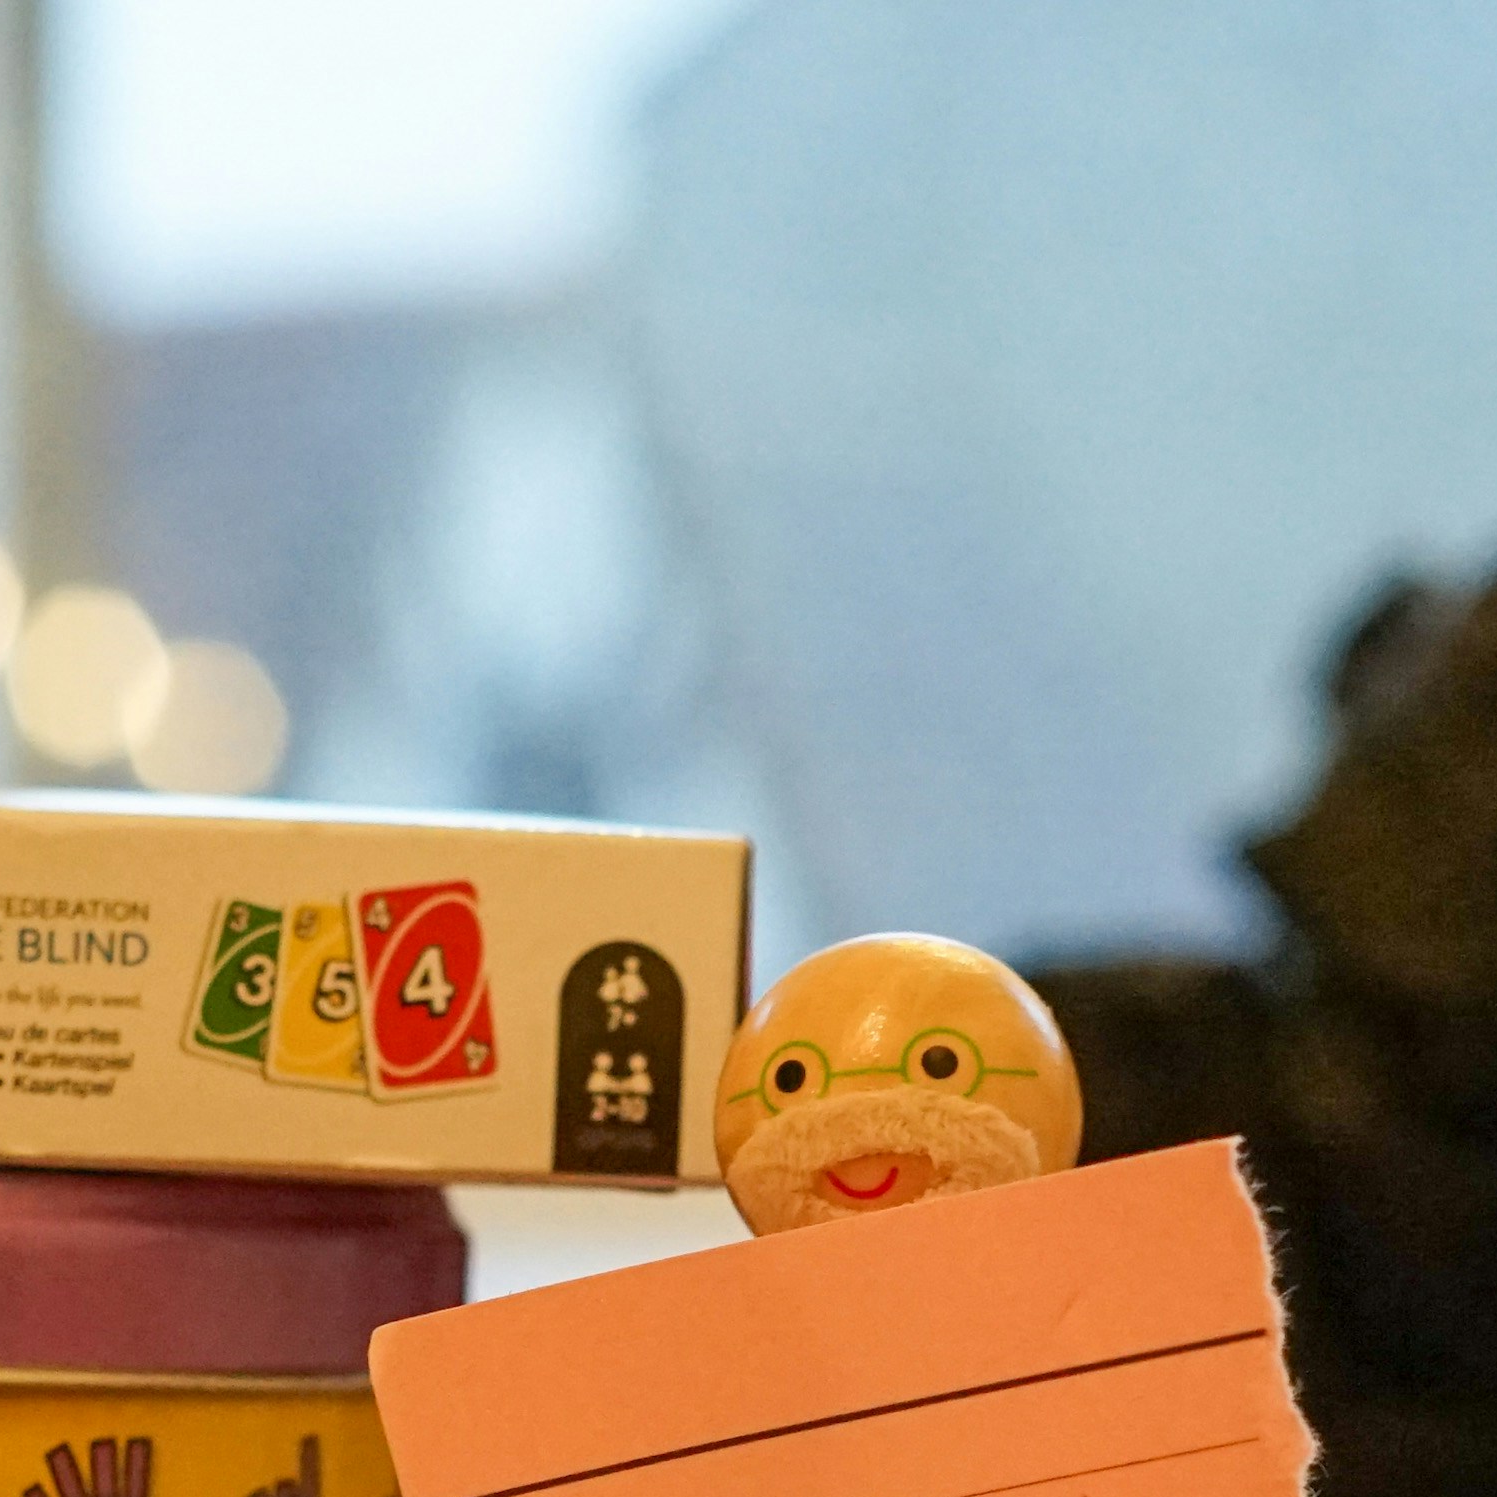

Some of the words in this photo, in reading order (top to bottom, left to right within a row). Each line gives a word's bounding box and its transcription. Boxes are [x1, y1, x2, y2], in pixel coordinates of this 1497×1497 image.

[364, 896, 392, 932] 4
[17, 926, 150, 967] BLIND
[235, 953, 275, 1008] 3
[313, 958, 359, 1022] 5
[401, 943, 456, 1018] 4
[21, 1023, 49, 1044] de
[53, 1025, 121, 1046] cartes
